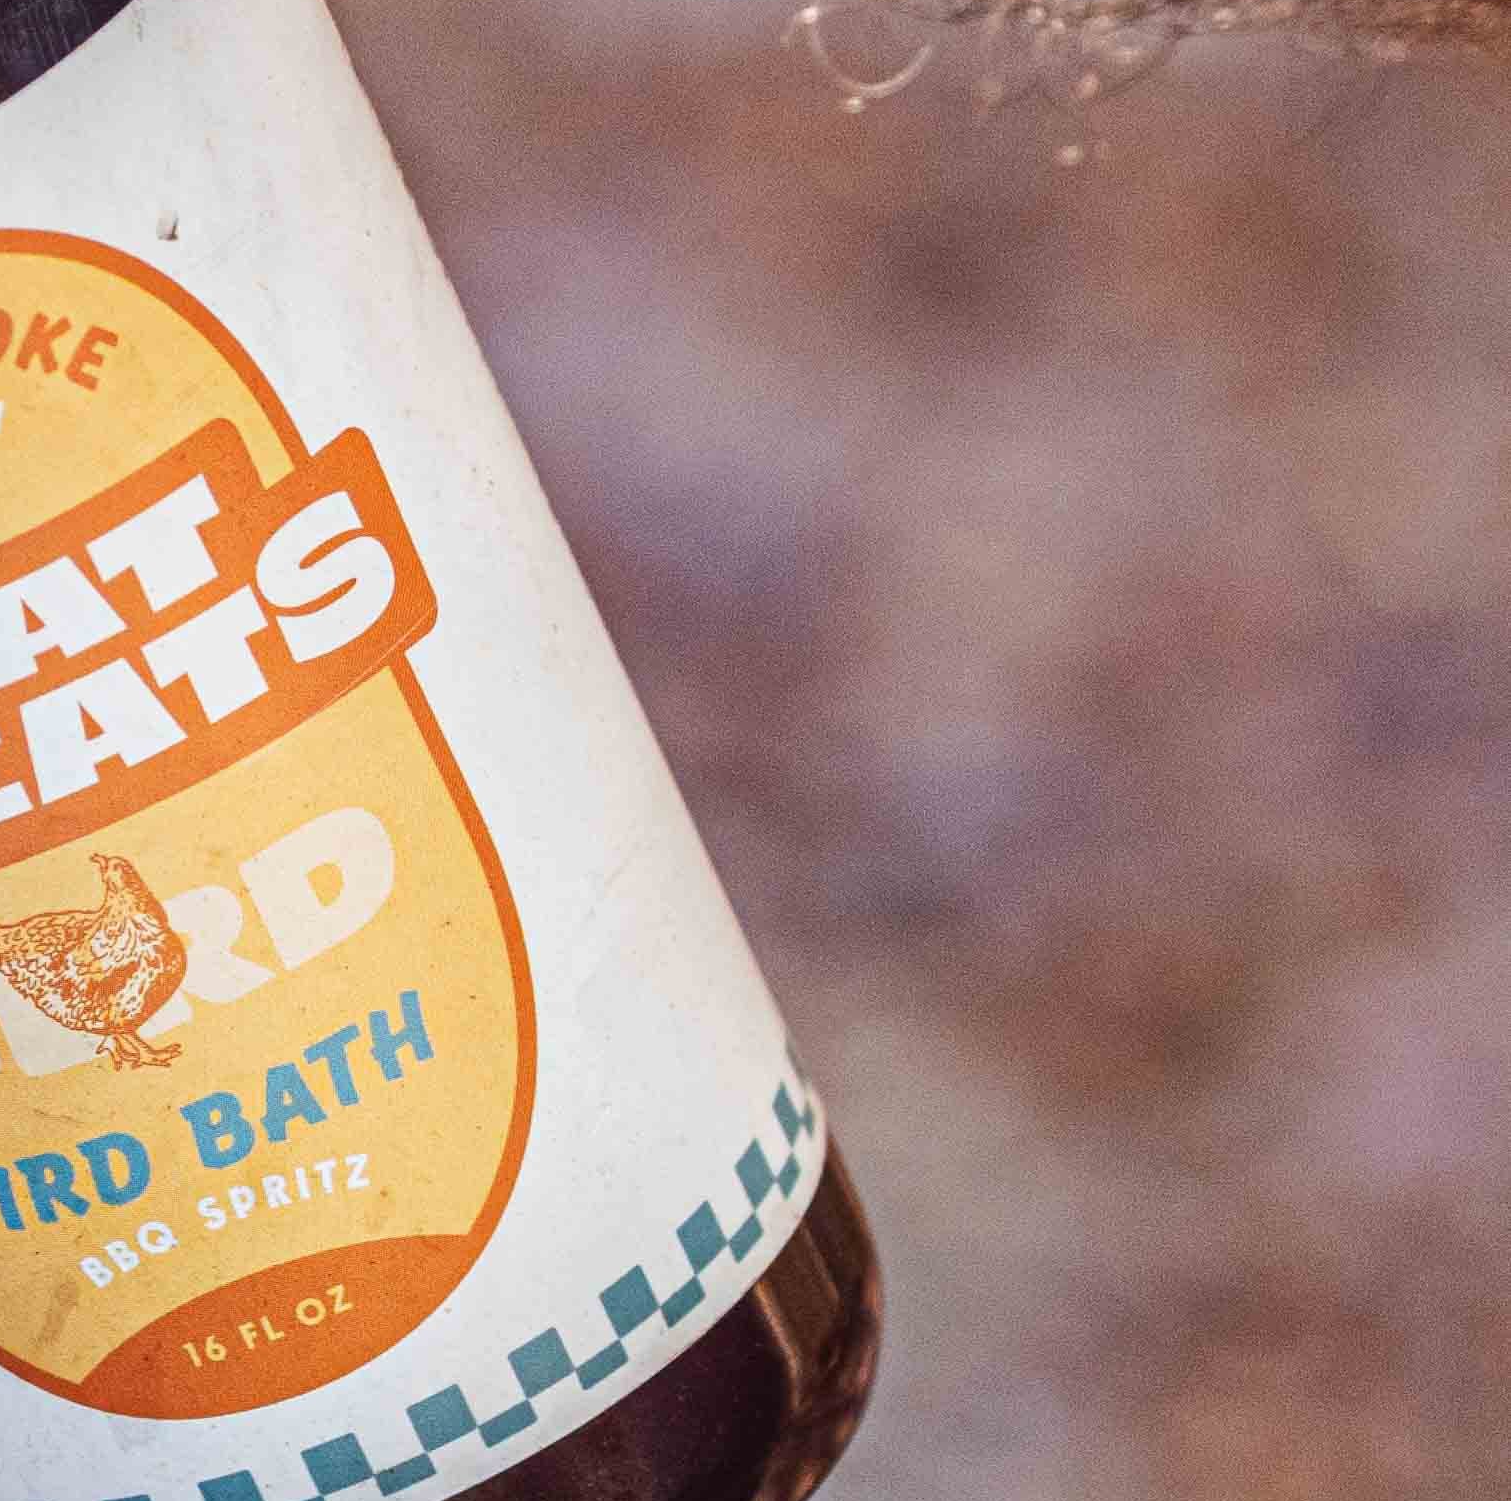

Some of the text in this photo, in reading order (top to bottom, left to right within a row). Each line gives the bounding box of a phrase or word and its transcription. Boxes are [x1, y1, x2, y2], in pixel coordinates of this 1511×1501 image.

[180, 990, 435, 1169] BATH
[78, 1153, 370, 1289] BBQ SPRITZ
[182, 1284, 353, 1368] 16 FL OZ
